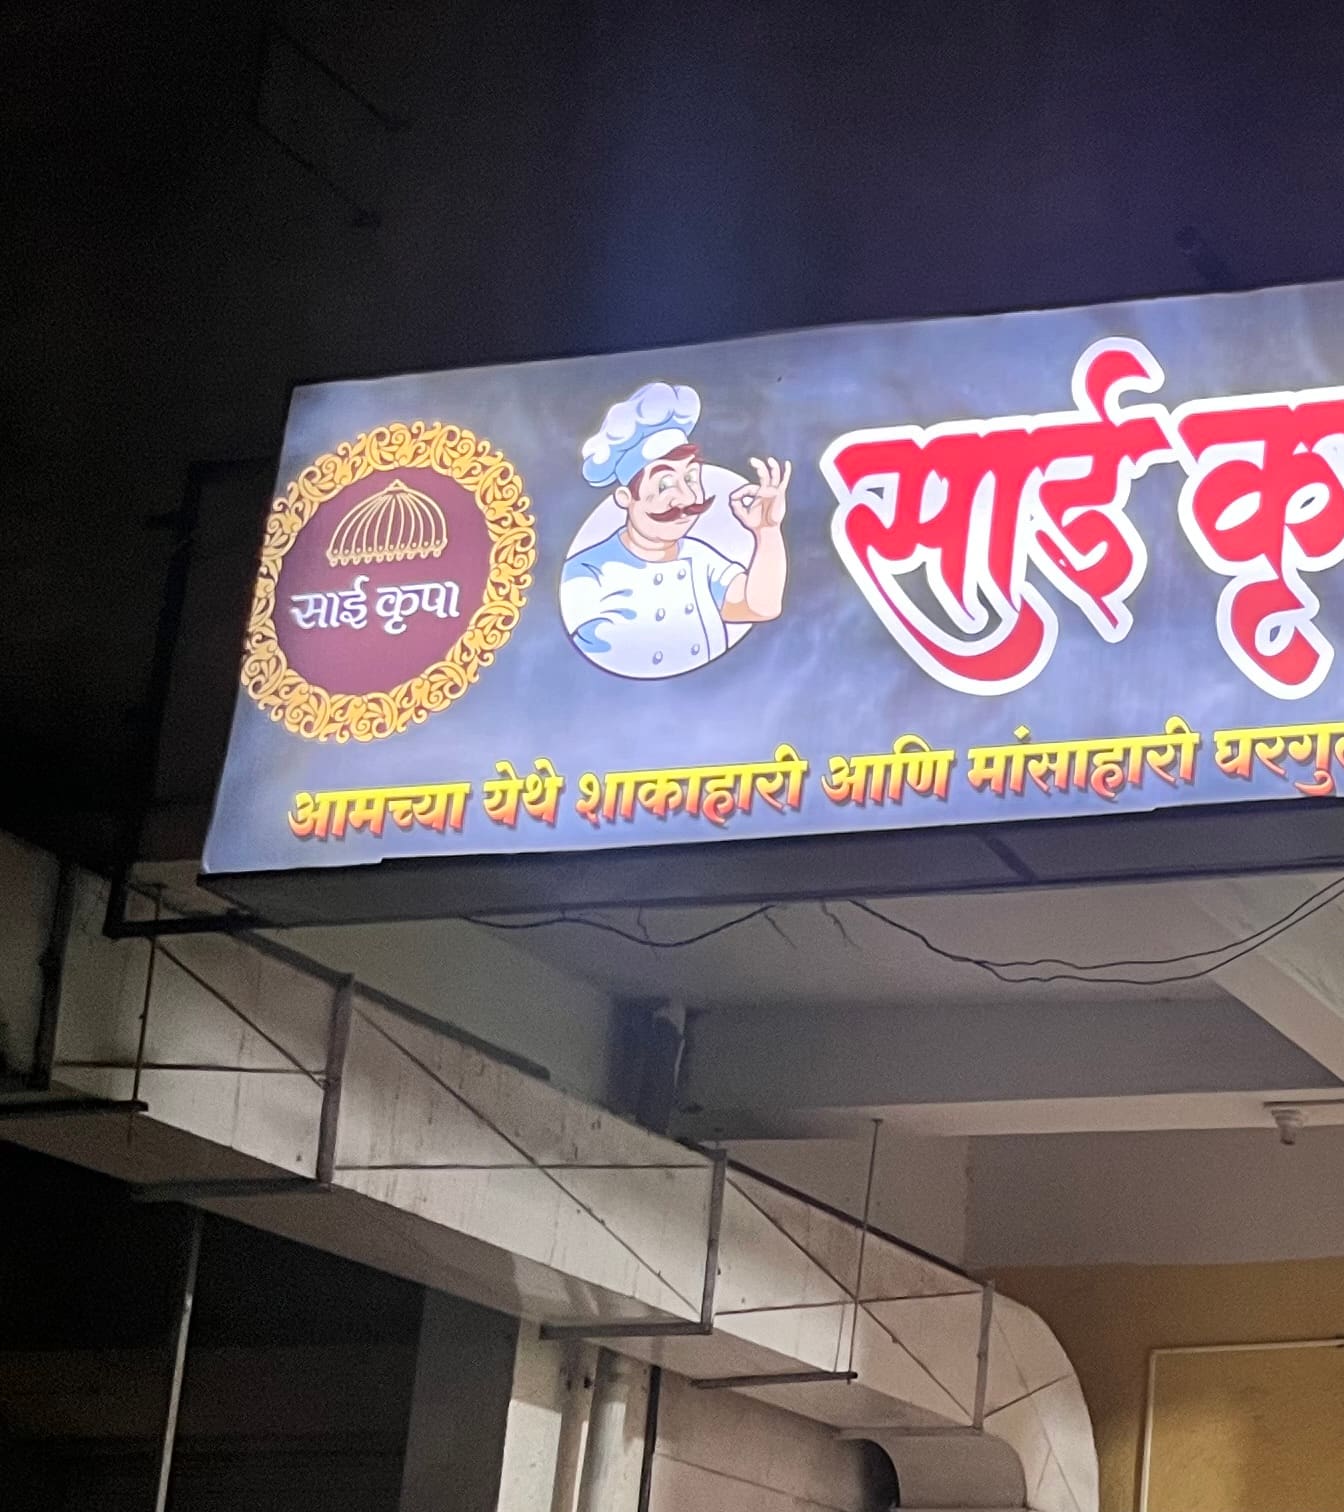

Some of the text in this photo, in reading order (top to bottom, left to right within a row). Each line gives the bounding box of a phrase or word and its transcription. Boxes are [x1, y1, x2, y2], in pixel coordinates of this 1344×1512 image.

[820, 337, 1180, 696] साई
[289, 573, 461, 635] साई कृपा
[288, 780, 471, 842] आमच्या
[483, 756, 563, 828] येथे
[576, 743, 808, 827] शाकाहारी
[821, 734, 957, 806] आणि
[968, 713, 1200, 799] मांसाहारी
